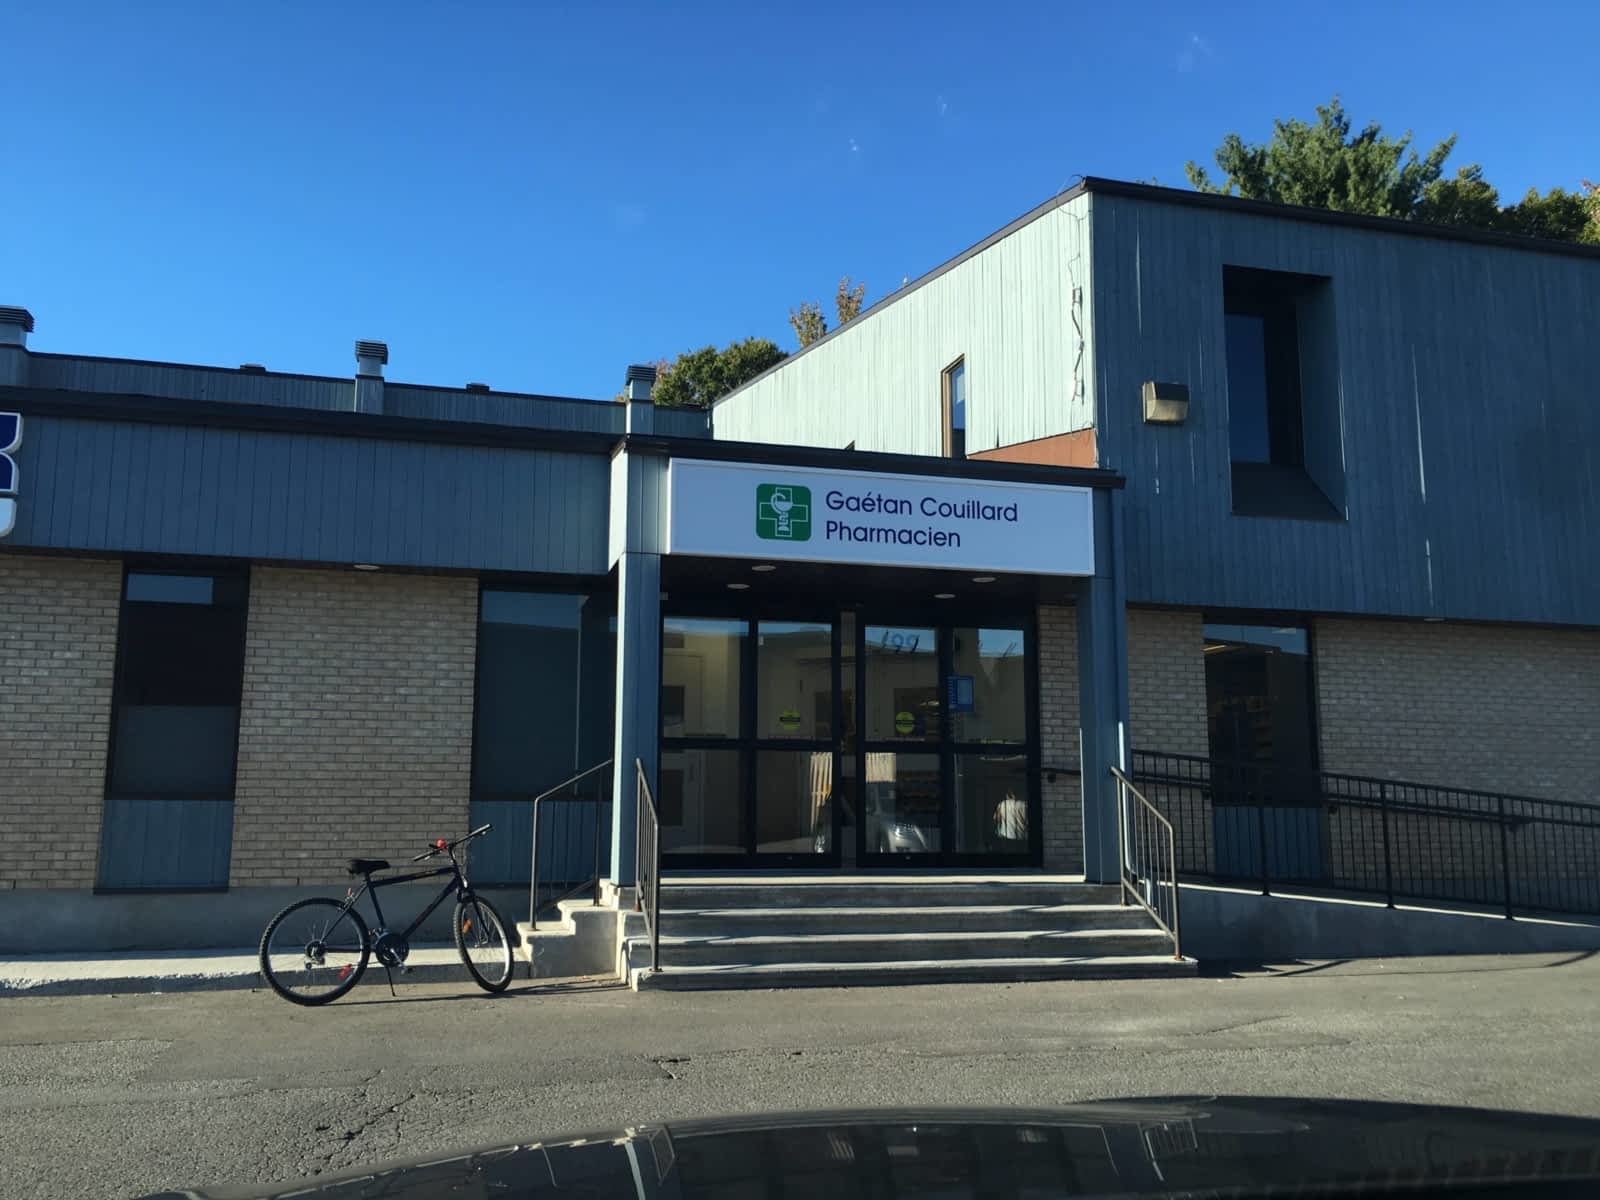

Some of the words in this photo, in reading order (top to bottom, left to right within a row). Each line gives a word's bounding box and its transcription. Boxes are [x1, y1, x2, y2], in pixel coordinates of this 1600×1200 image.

[825, 490, 912, 515] Gaétan
[919, 496, 1018, 522] Couillard
[825, 520, 961, 547] Pharmacien
